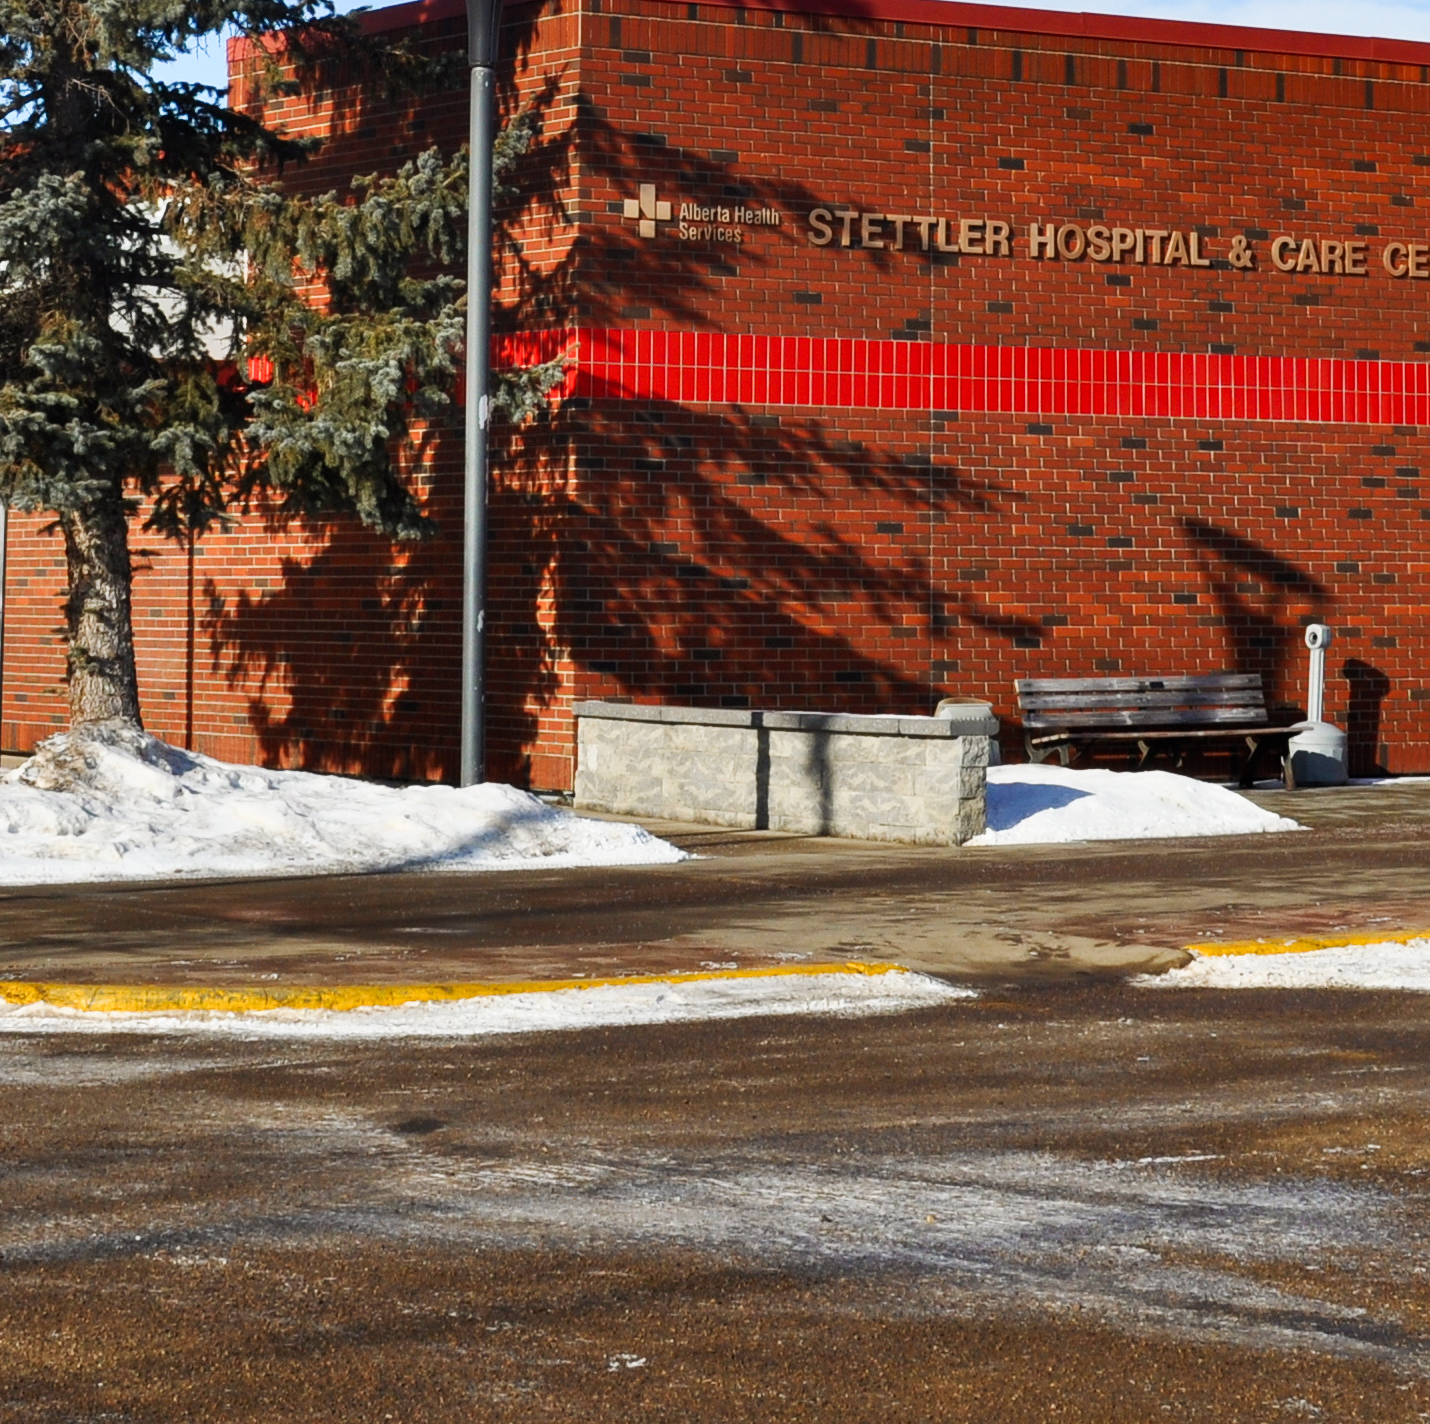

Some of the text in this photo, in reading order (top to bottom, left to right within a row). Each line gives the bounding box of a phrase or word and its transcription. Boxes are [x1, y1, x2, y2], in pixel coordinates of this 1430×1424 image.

[679, 203, 780, 225] Alberta Health
[678, 222, 742, 243] Services
[807, 208, 1010, 256] STETTLER
[1029, 222, 1211, 267] HOSPITAL
[1228, 234, 1253, 269] &
[1271, 235, 1366, 274] CARE
